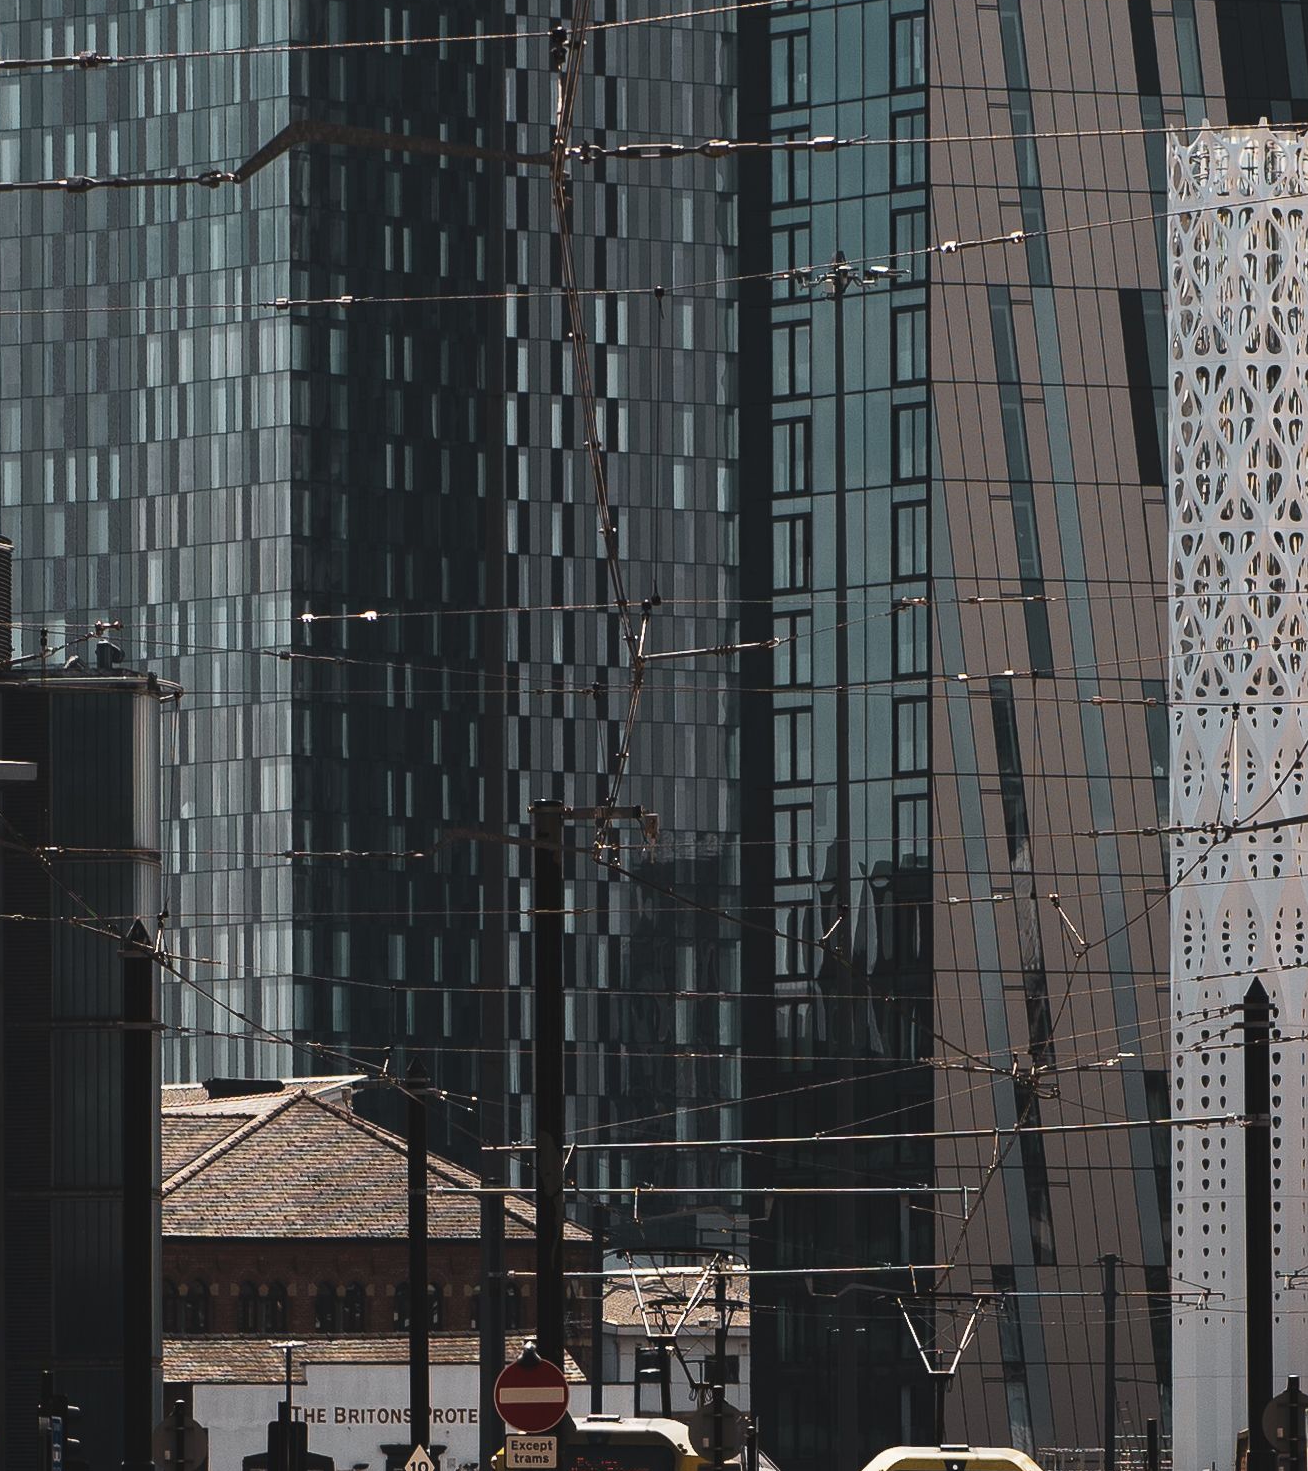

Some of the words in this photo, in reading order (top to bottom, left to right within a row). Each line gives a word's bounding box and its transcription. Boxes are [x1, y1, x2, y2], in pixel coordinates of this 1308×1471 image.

[291, 1406, 327, 1424] THE
[334, 1407, 411, 1424] BRITONS
[511, 1440, 553, 1452] Except
[514, 1453, 550, 1463] trams
